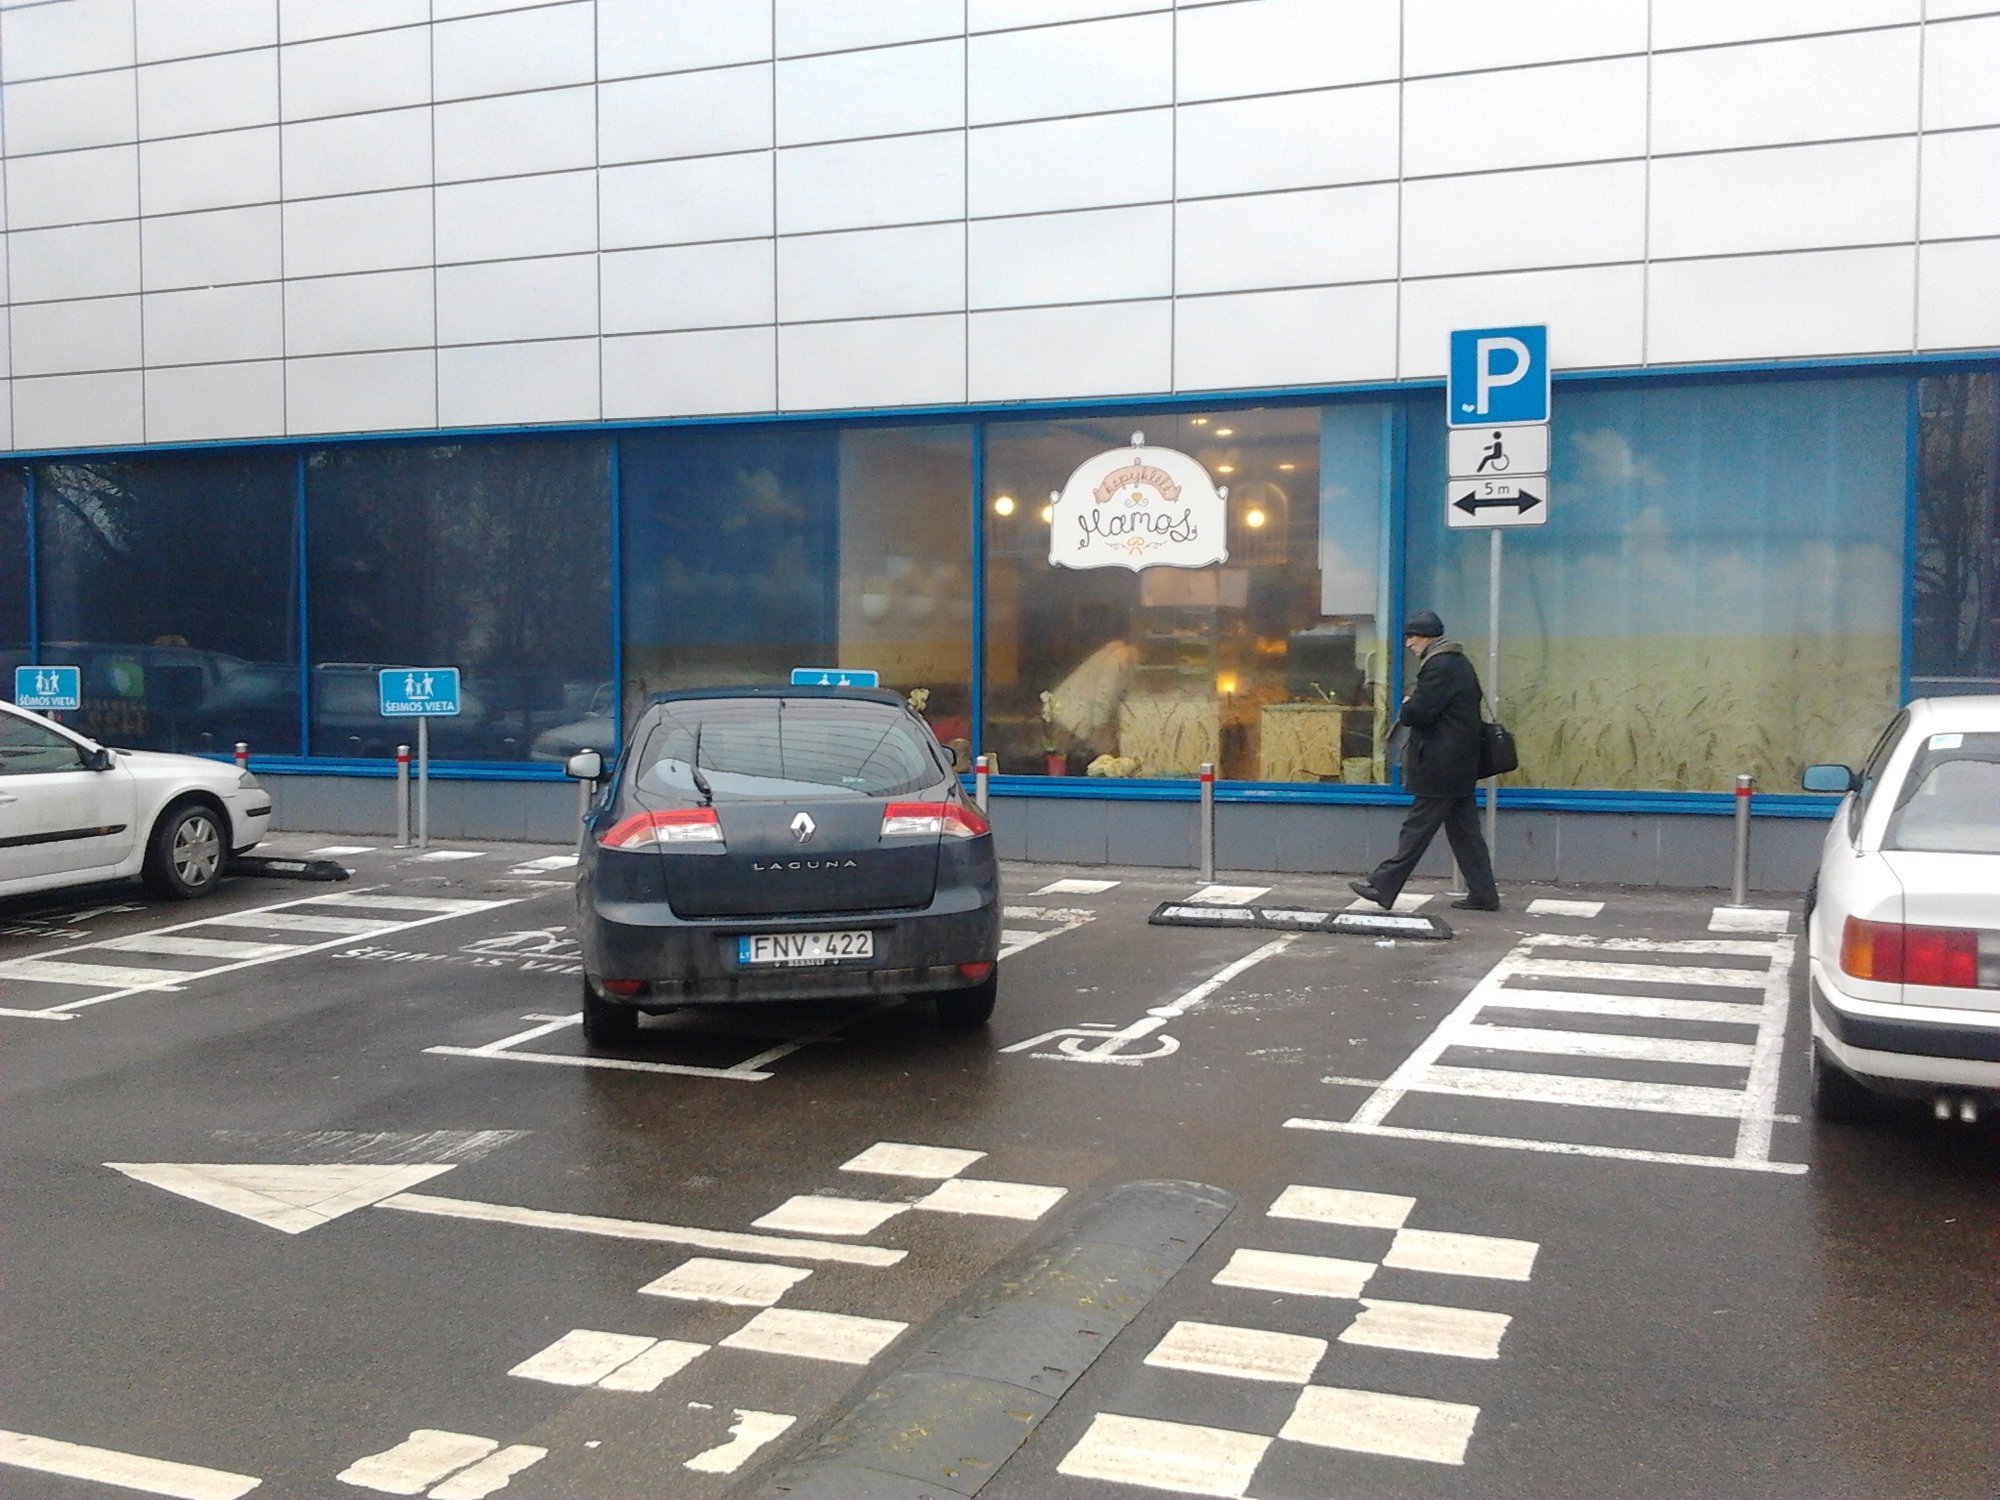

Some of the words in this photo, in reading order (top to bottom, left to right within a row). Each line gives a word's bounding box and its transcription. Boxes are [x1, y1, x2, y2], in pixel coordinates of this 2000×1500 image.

[1477, 336, 1531, 415] P
[1484, 482, 1493, 495] 5
[1497, 484, 1510, 495] m
[1078, 508, 1198, 550] Mamos
[51, 696, 76, 706] VIETA
[385, 699, 423, 712] ŠEIMOS
[424, 700, 455, 712] VIETA
[752, 857, 858, 871] LAGUNA
[754, 935, 807, 960] FNV
[825, 933, 869, 956] 422
[739, 951, 751, 960] LT
